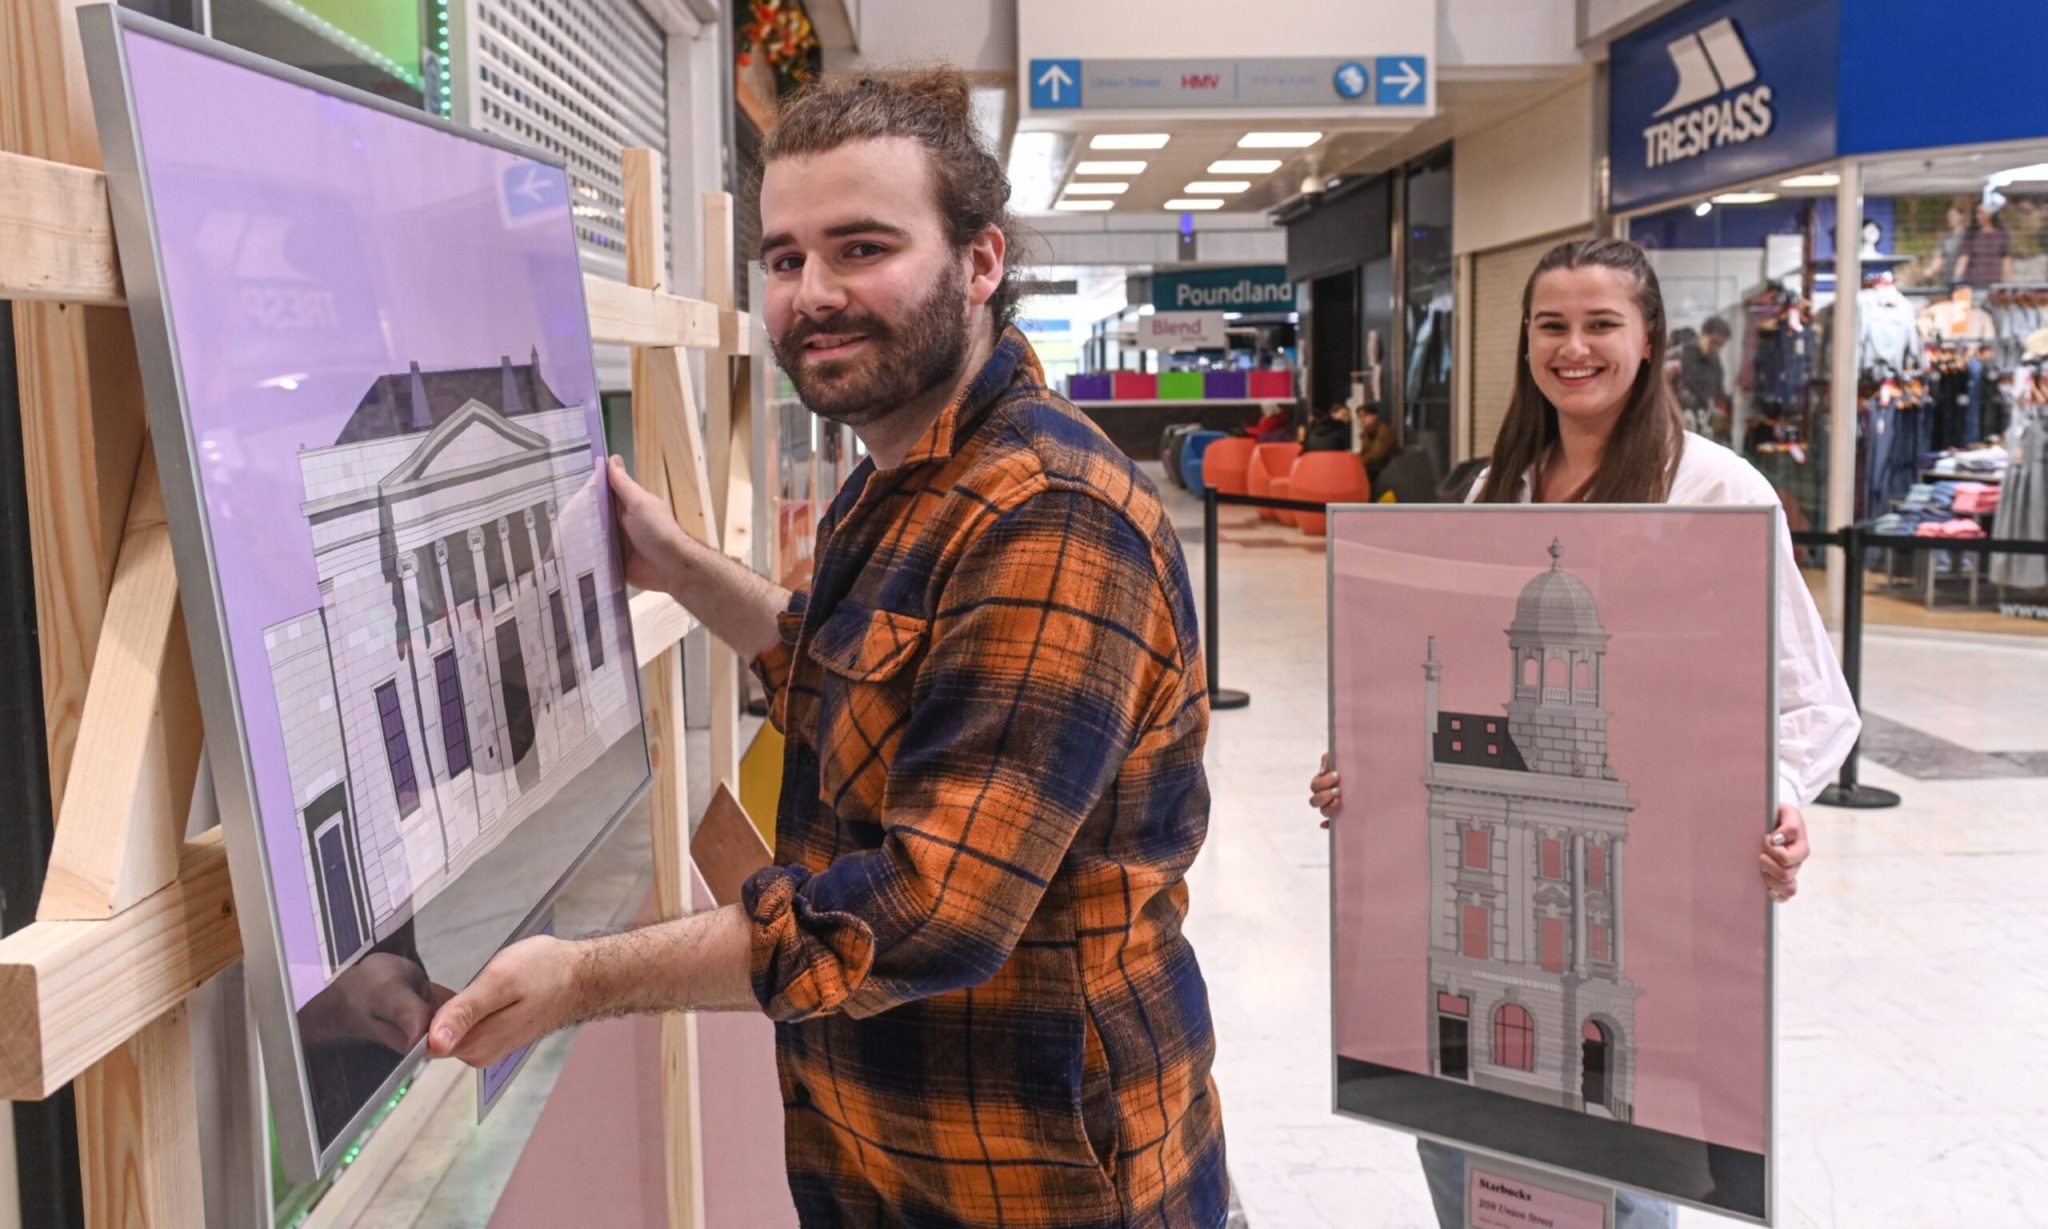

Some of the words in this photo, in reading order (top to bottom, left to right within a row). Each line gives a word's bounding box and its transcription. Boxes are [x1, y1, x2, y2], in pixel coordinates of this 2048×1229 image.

[1181, 75, 1219, 90] HMV
[1643, 85, 1773, 168] TRESPASS
[1177, 281, 1292, 306] Poundland
[1152, 319, 1201, 336] Blend
[1479, 1178, 1532, 1202] Starbucks
[1498, 1205, 1526, 1221] Union
[1528, 1212, 1554, 1228] Street
